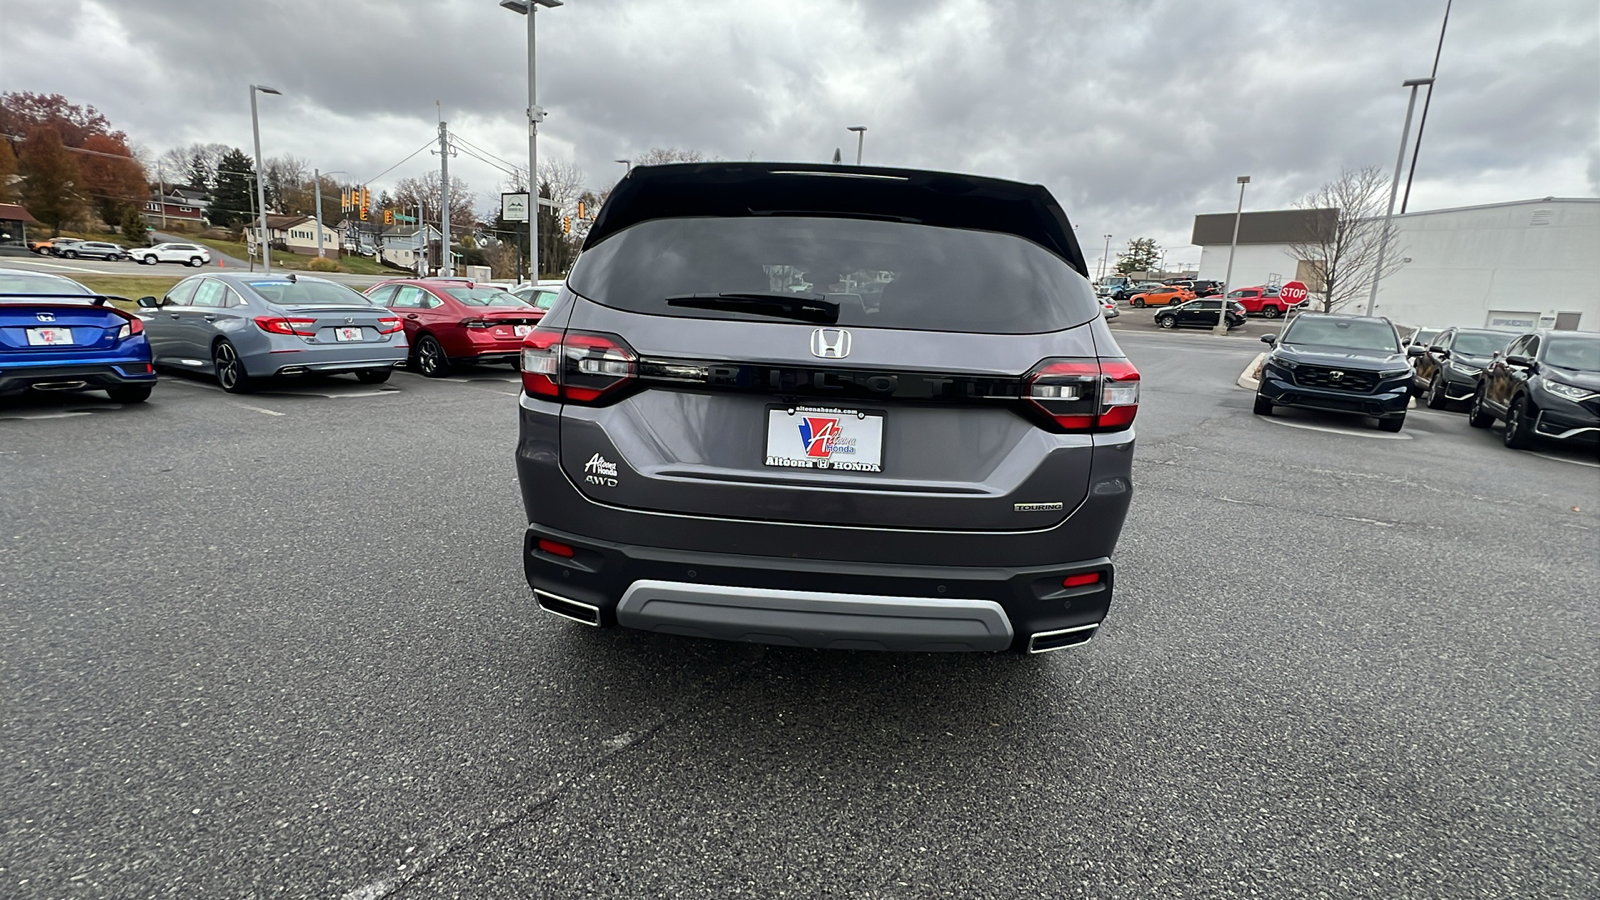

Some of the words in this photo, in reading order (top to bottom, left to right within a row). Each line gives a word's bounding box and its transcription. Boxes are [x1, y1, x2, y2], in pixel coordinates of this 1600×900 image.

[1281, 287, 1307, 299] STOP
[708, 364, 954, 397] PILOT
[795, 406, 858, 415] altoonahonda.com
[825, 444, 855, 454] Honda
[765, 456, 814, 468] Altoona
[833, 461, 881, 472] HONDA
[584, 475, 619, 488] AWD
[1014, 503, 1063, 511] TOURING
